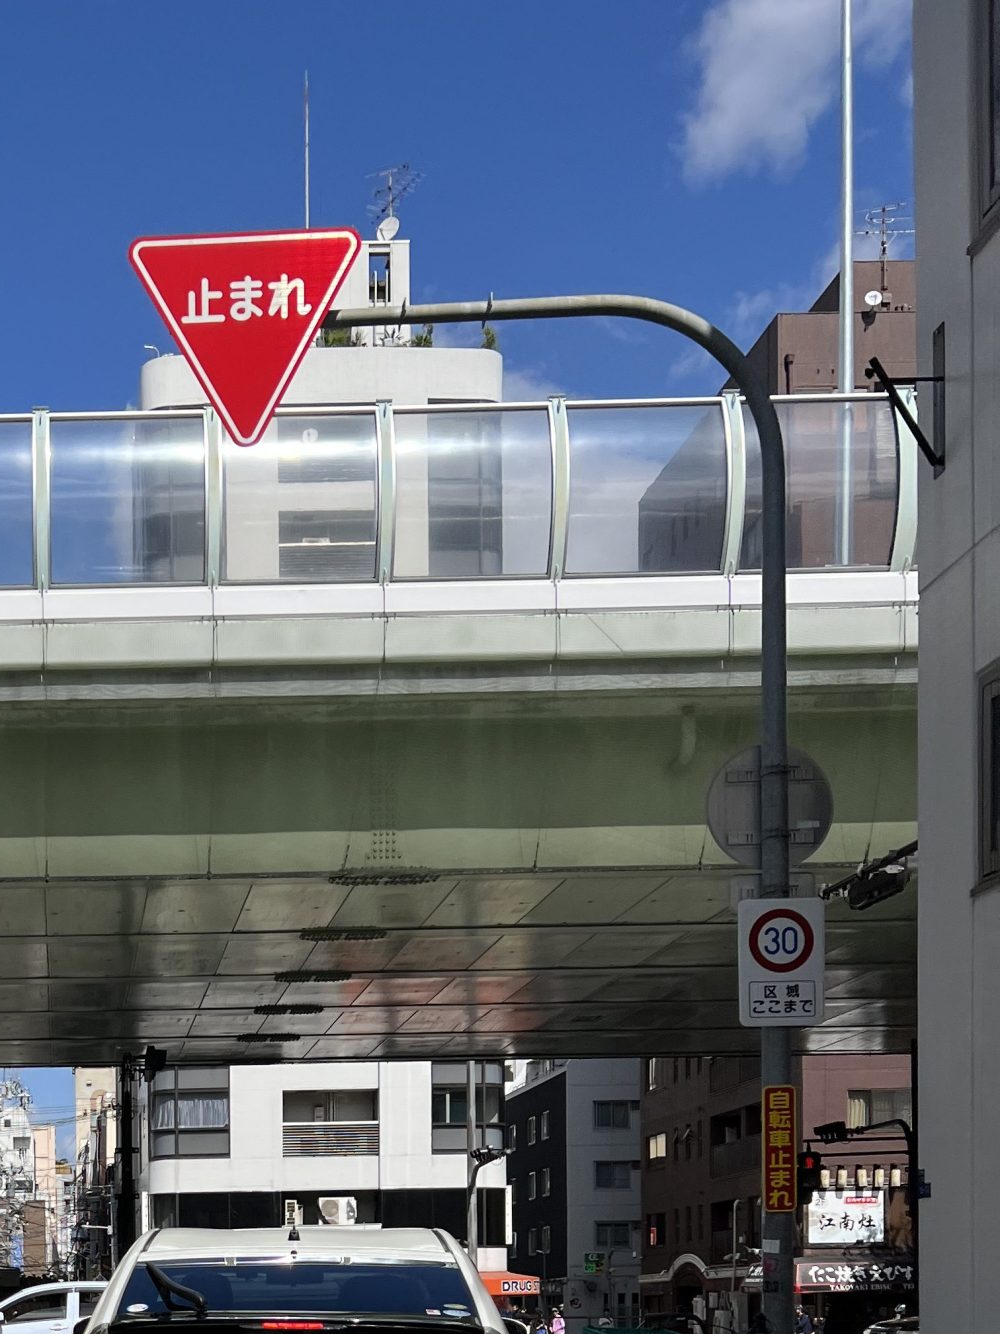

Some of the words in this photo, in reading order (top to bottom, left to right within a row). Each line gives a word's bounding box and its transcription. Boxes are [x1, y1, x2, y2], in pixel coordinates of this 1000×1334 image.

[181, 273, 313, 324] 止まれ
[764, 926, 798, 955] 30
[764, 984, 800, 999] 区域
[752, 999, 814, 1014] ここまで
[768, 1090, 792, 1208] 自転車止まれ
[502, 1280, 532, 1292] DRUG
